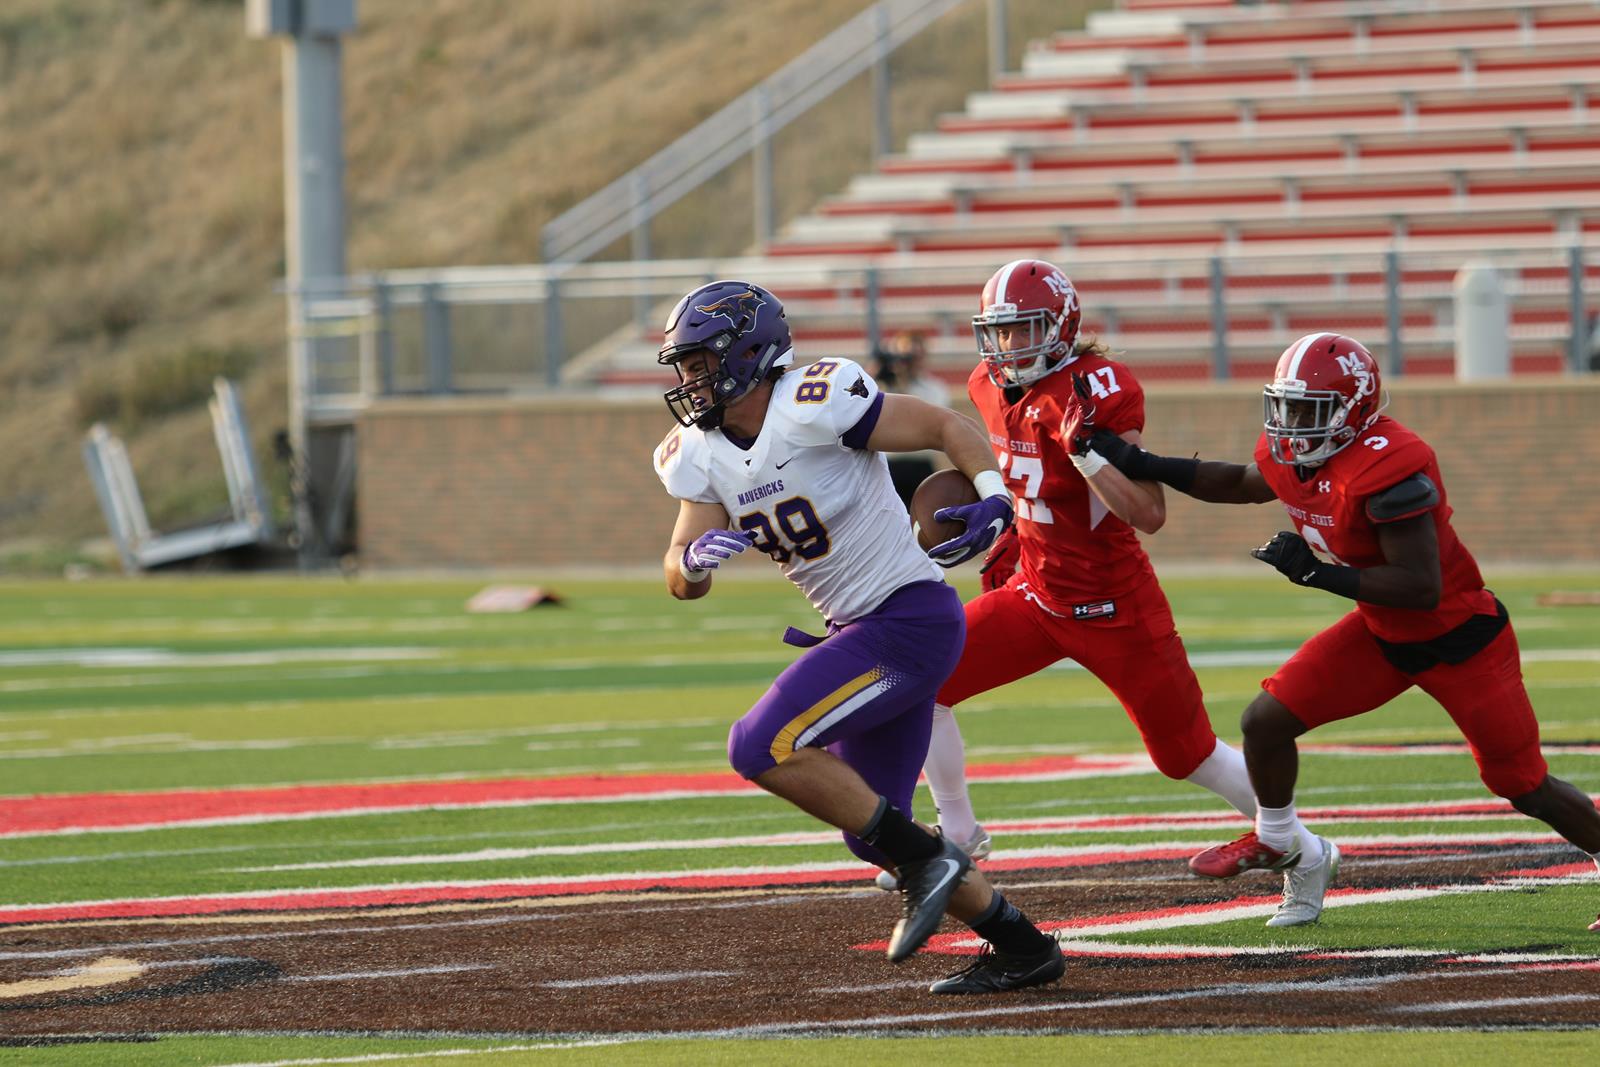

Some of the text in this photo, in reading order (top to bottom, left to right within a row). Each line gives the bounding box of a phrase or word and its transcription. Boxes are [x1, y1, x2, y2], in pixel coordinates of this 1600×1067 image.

[794, 361, 840, 405] 89
[1087, 366, 1121, 400] 47
[1010, 439, 1038, 454] STATE
[1364, 435, 1389, 450] 3
[737, 479, 785, 506] MAVERICKS
[1310, 513, 1336, 527] STATE
